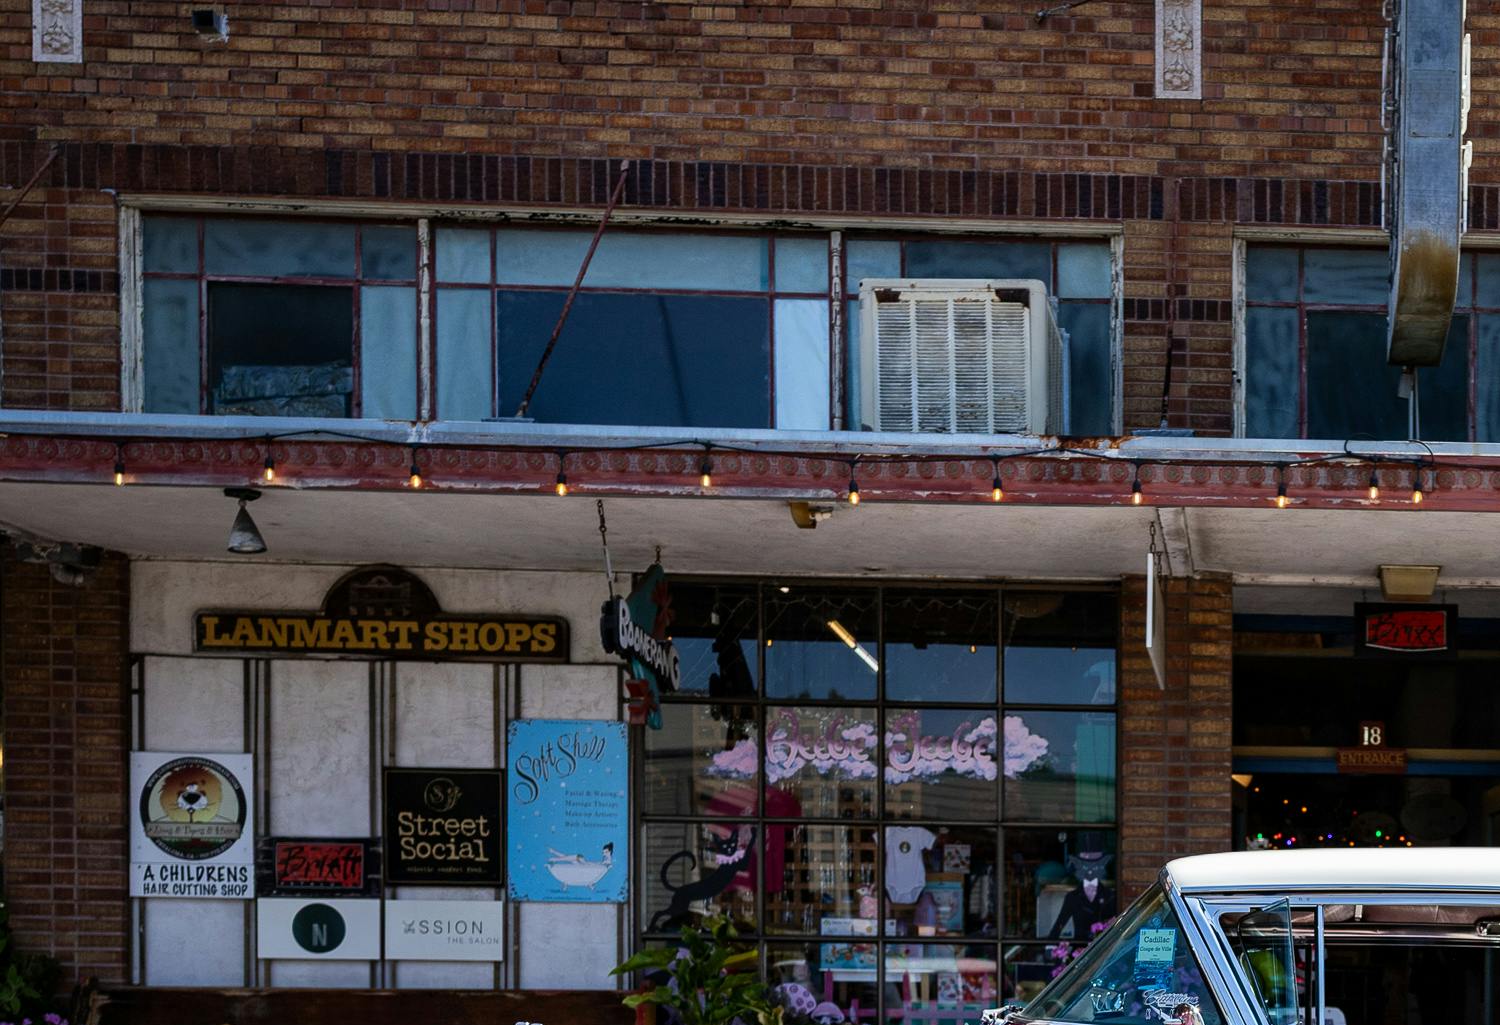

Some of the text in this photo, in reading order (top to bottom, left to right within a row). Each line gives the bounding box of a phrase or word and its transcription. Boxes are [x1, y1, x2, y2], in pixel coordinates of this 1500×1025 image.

[201, 617, 555, 652] LANMART SHOPS
[618, 598, 680, 691] BOOMERANG
[1363, 726, 1382, 746] 18
[514, 732, 606, 805] Soft Shell
[1340, 752, 1404, 765] ENTRANCE
[398, 811, 491, 837] Street
[400, 837, 489, 862] Social
[143, 865, 248, 882] A CHILDRENS
[143, 883, 248, 896] HAIR CUTTING SHOP
[312, 922, 328, 947] N
